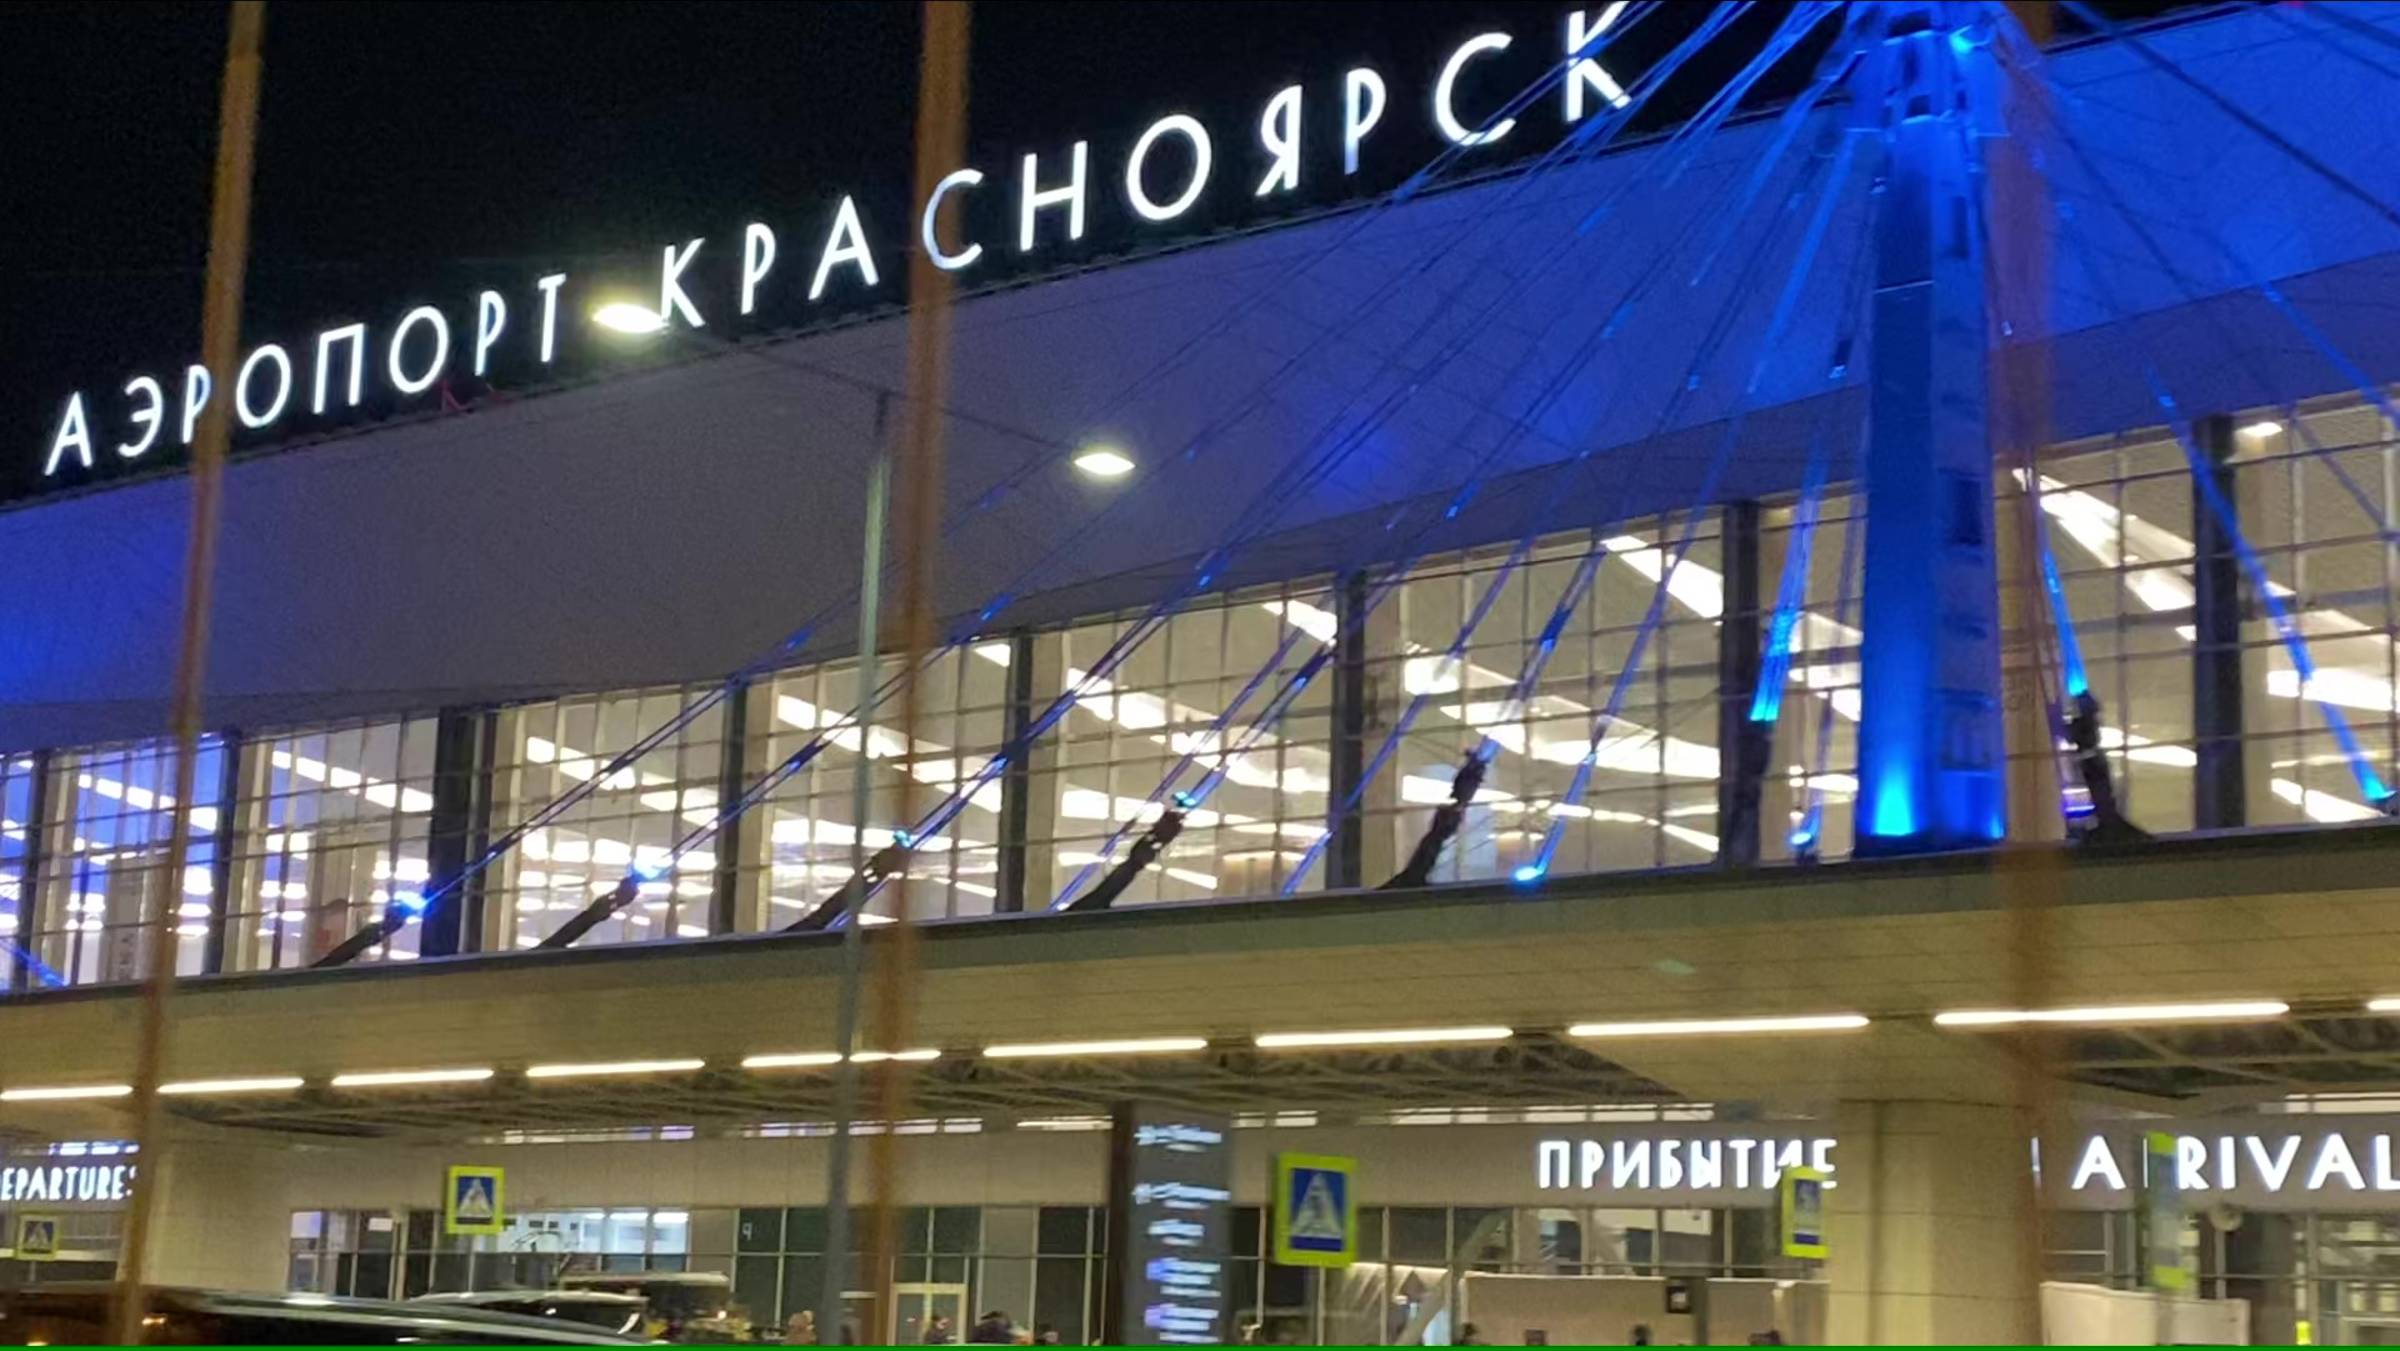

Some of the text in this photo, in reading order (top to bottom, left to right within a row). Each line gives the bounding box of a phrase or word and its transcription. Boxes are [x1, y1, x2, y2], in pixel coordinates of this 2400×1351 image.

[45, 1, 1631, 476] АЭРОПОРТ КРАСНОЯРСК
[1537, 1138, 1838, 1190] ПРИБЫТИЕ
[2071, 1133, 2400, 1192] ARIVAL
